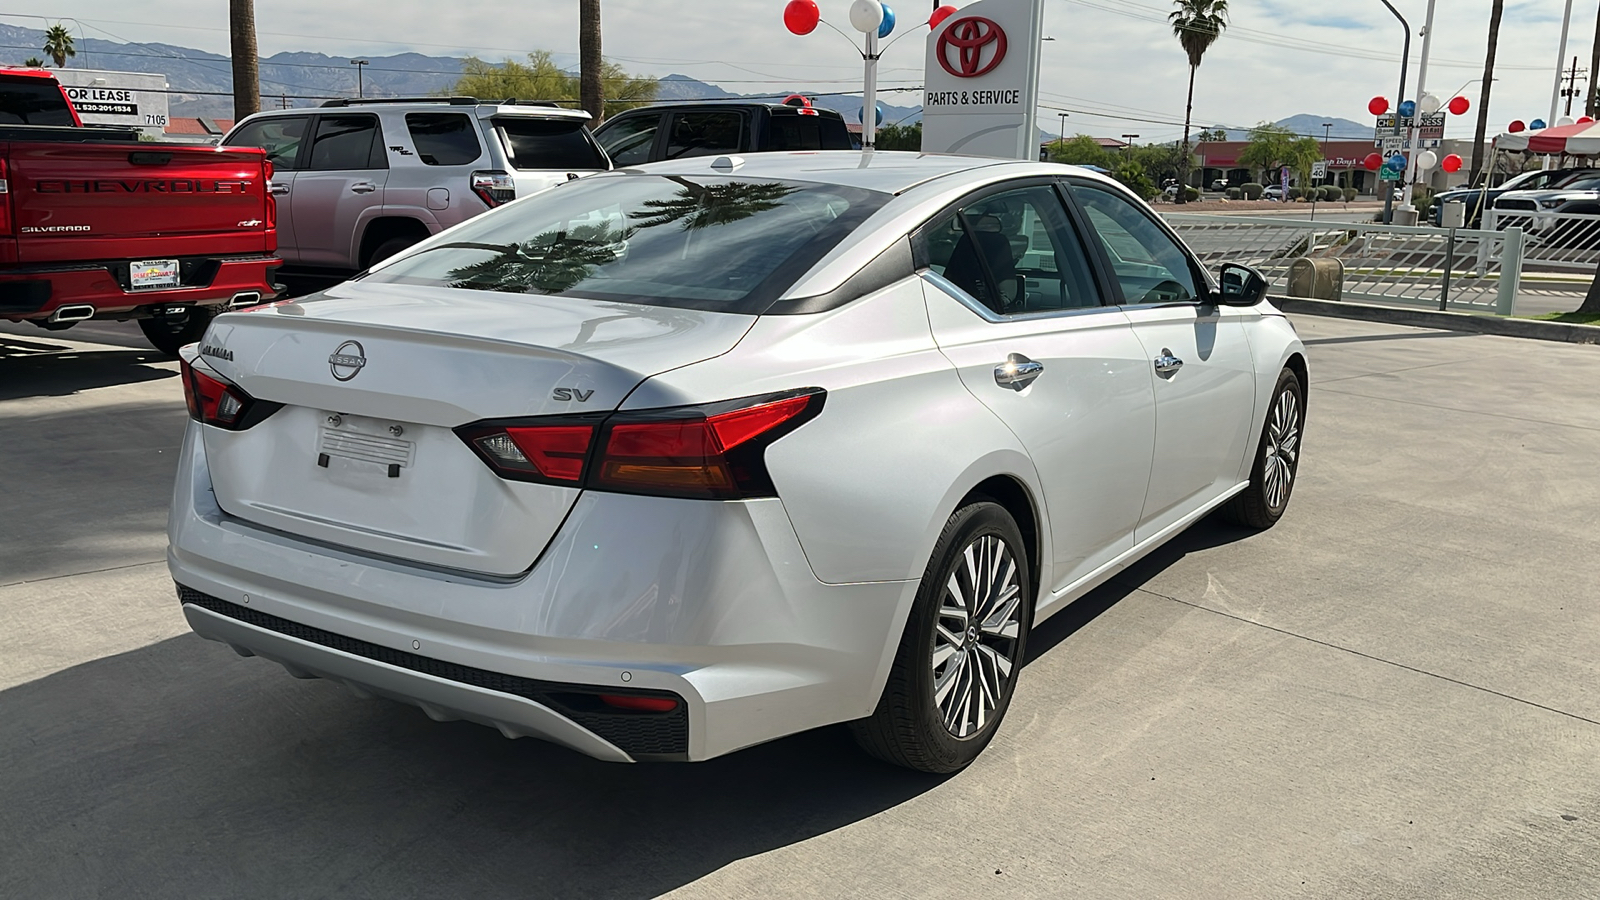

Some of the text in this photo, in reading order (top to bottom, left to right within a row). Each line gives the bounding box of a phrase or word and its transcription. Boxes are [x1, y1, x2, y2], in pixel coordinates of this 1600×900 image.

[93, 90, 131, 101] LEASE
[927, 90, 1019, 106] PARTS & SERVICE
[82, 104, 132, 112] 520-201-1534
[146, 114, 166, 125] 7105
[1407, 118, 1442, 127] FNESS
[1384, 150, 1400, 158] 40
[1336, 157, 1356, 168] Boys
[36, 180, 252, 194] CHEVROLET
[21, 225, 91, 234] SILVERADO
[329, 353, 366, 367] NISSAN
[553, 387, 595, 402] SV
